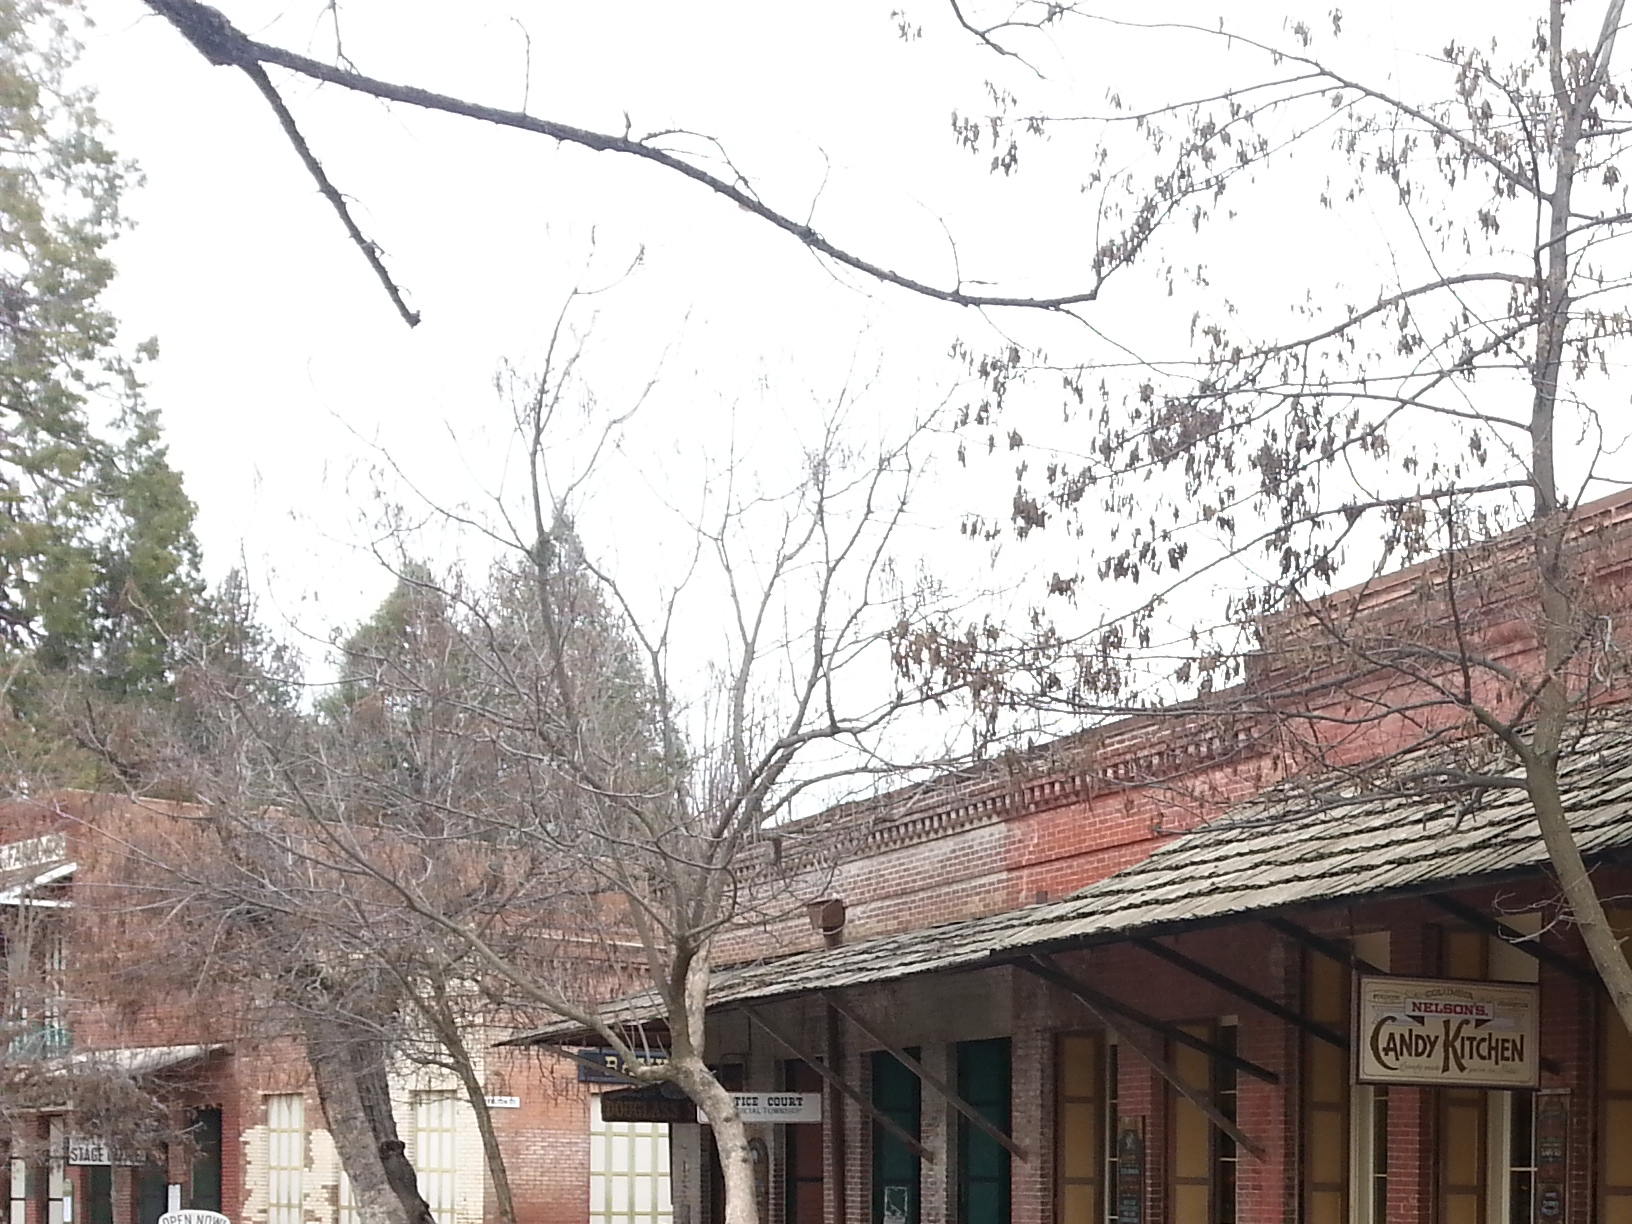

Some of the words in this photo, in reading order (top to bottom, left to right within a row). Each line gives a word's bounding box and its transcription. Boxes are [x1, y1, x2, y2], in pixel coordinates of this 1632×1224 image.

[1370, 1015, 1440, 1071] CANDY
[1441, 1019, 1525, 1074] KITCHEN
[734, 1097, 759, 1107] TICE
[767, 1097, 804, 1107] COURT
[70, 1146, 105, 1162] STAGE
